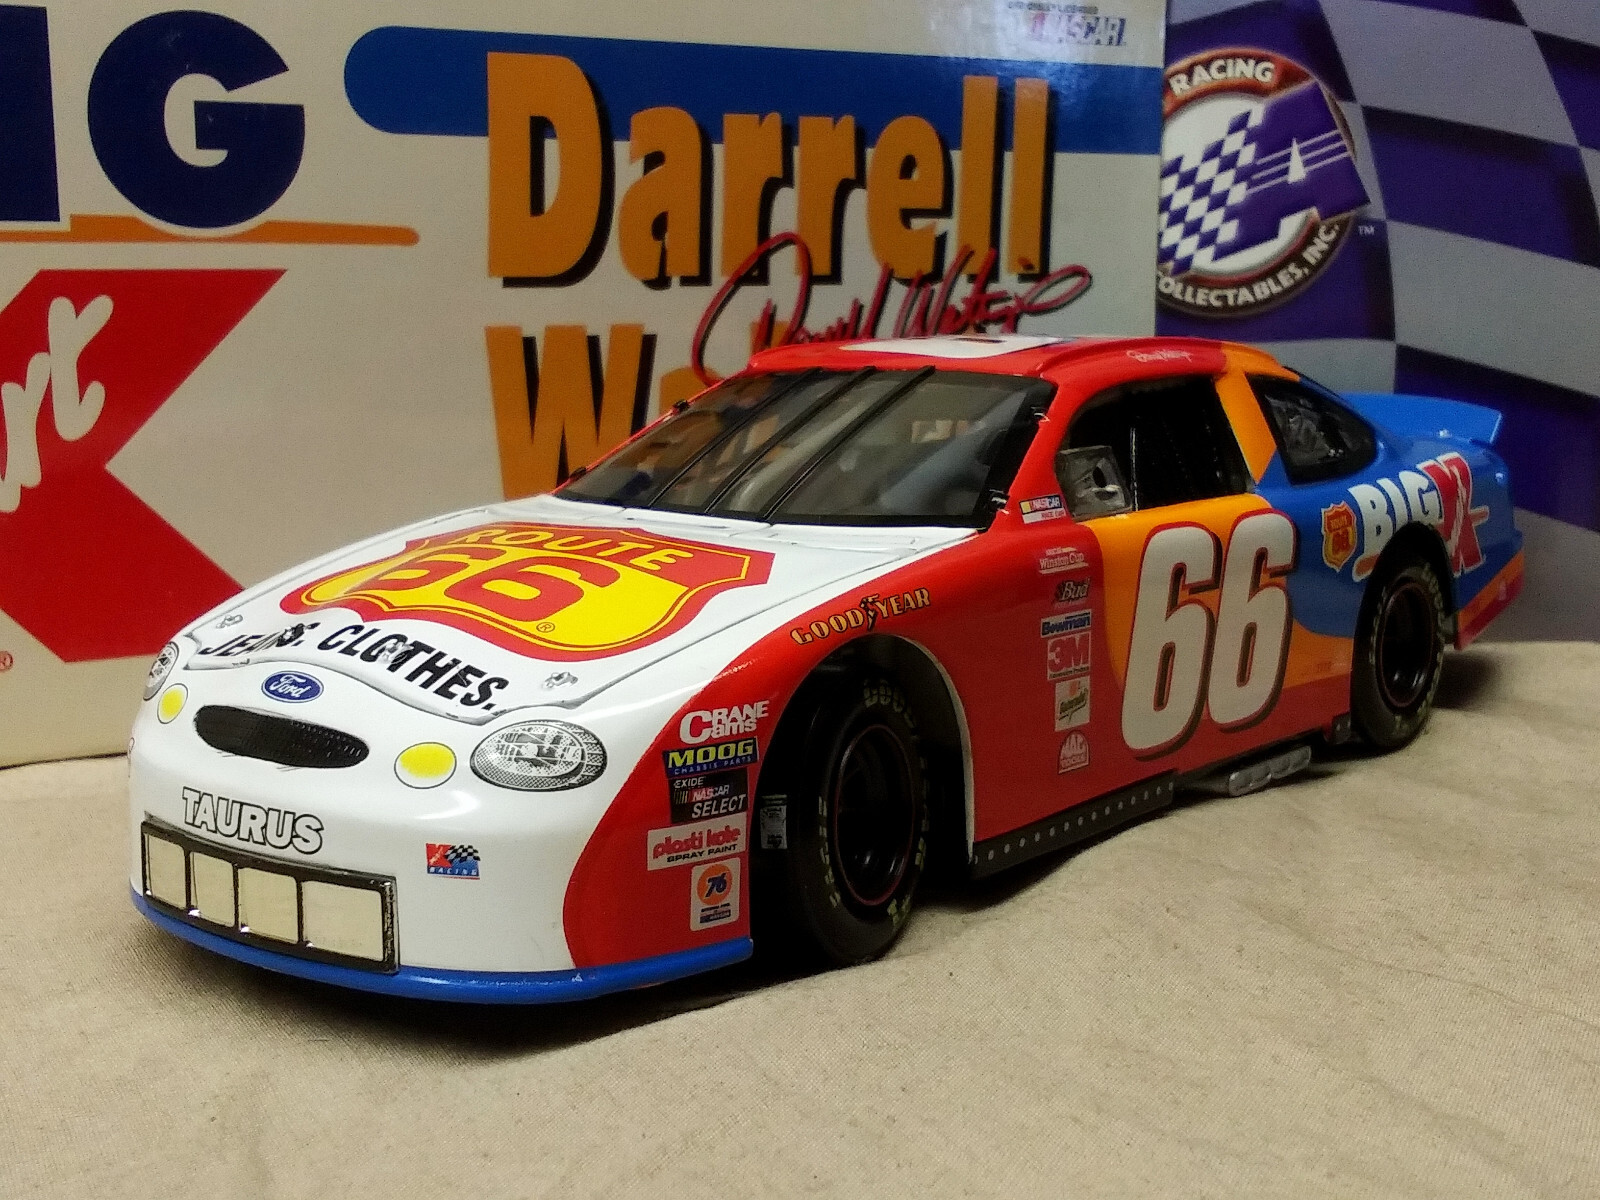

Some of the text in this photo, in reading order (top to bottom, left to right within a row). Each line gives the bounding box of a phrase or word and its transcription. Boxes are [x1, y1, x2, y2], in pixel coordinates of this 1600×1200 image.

[1169, 58, 1275, 97] RACING
[487, 52, 1055, 290] Darrell
[1348, 470, 1445, 556] BIG
[450, 528, 694, 571] ROUTE
[345, 546, 621, 623] 66
[1121, 510, 1296, 754] 66
[1049, 633, 1090, 672] 3M
[268, 673, 313, 698] Ford
[668, 740, 754, 769] MOOG
[674, 756, 752, 775] CHASSIS PARTS
[673, 776, 706, 788] EXIDE
[692, 785, 730, 802] NASCAR
[182, 786, 324, 854] TAURUS
[691, 794, 746, 818] SELECT
[666, 844, 737, 862] SPRAY PAINT
[705, 872, 727, 897] 76
